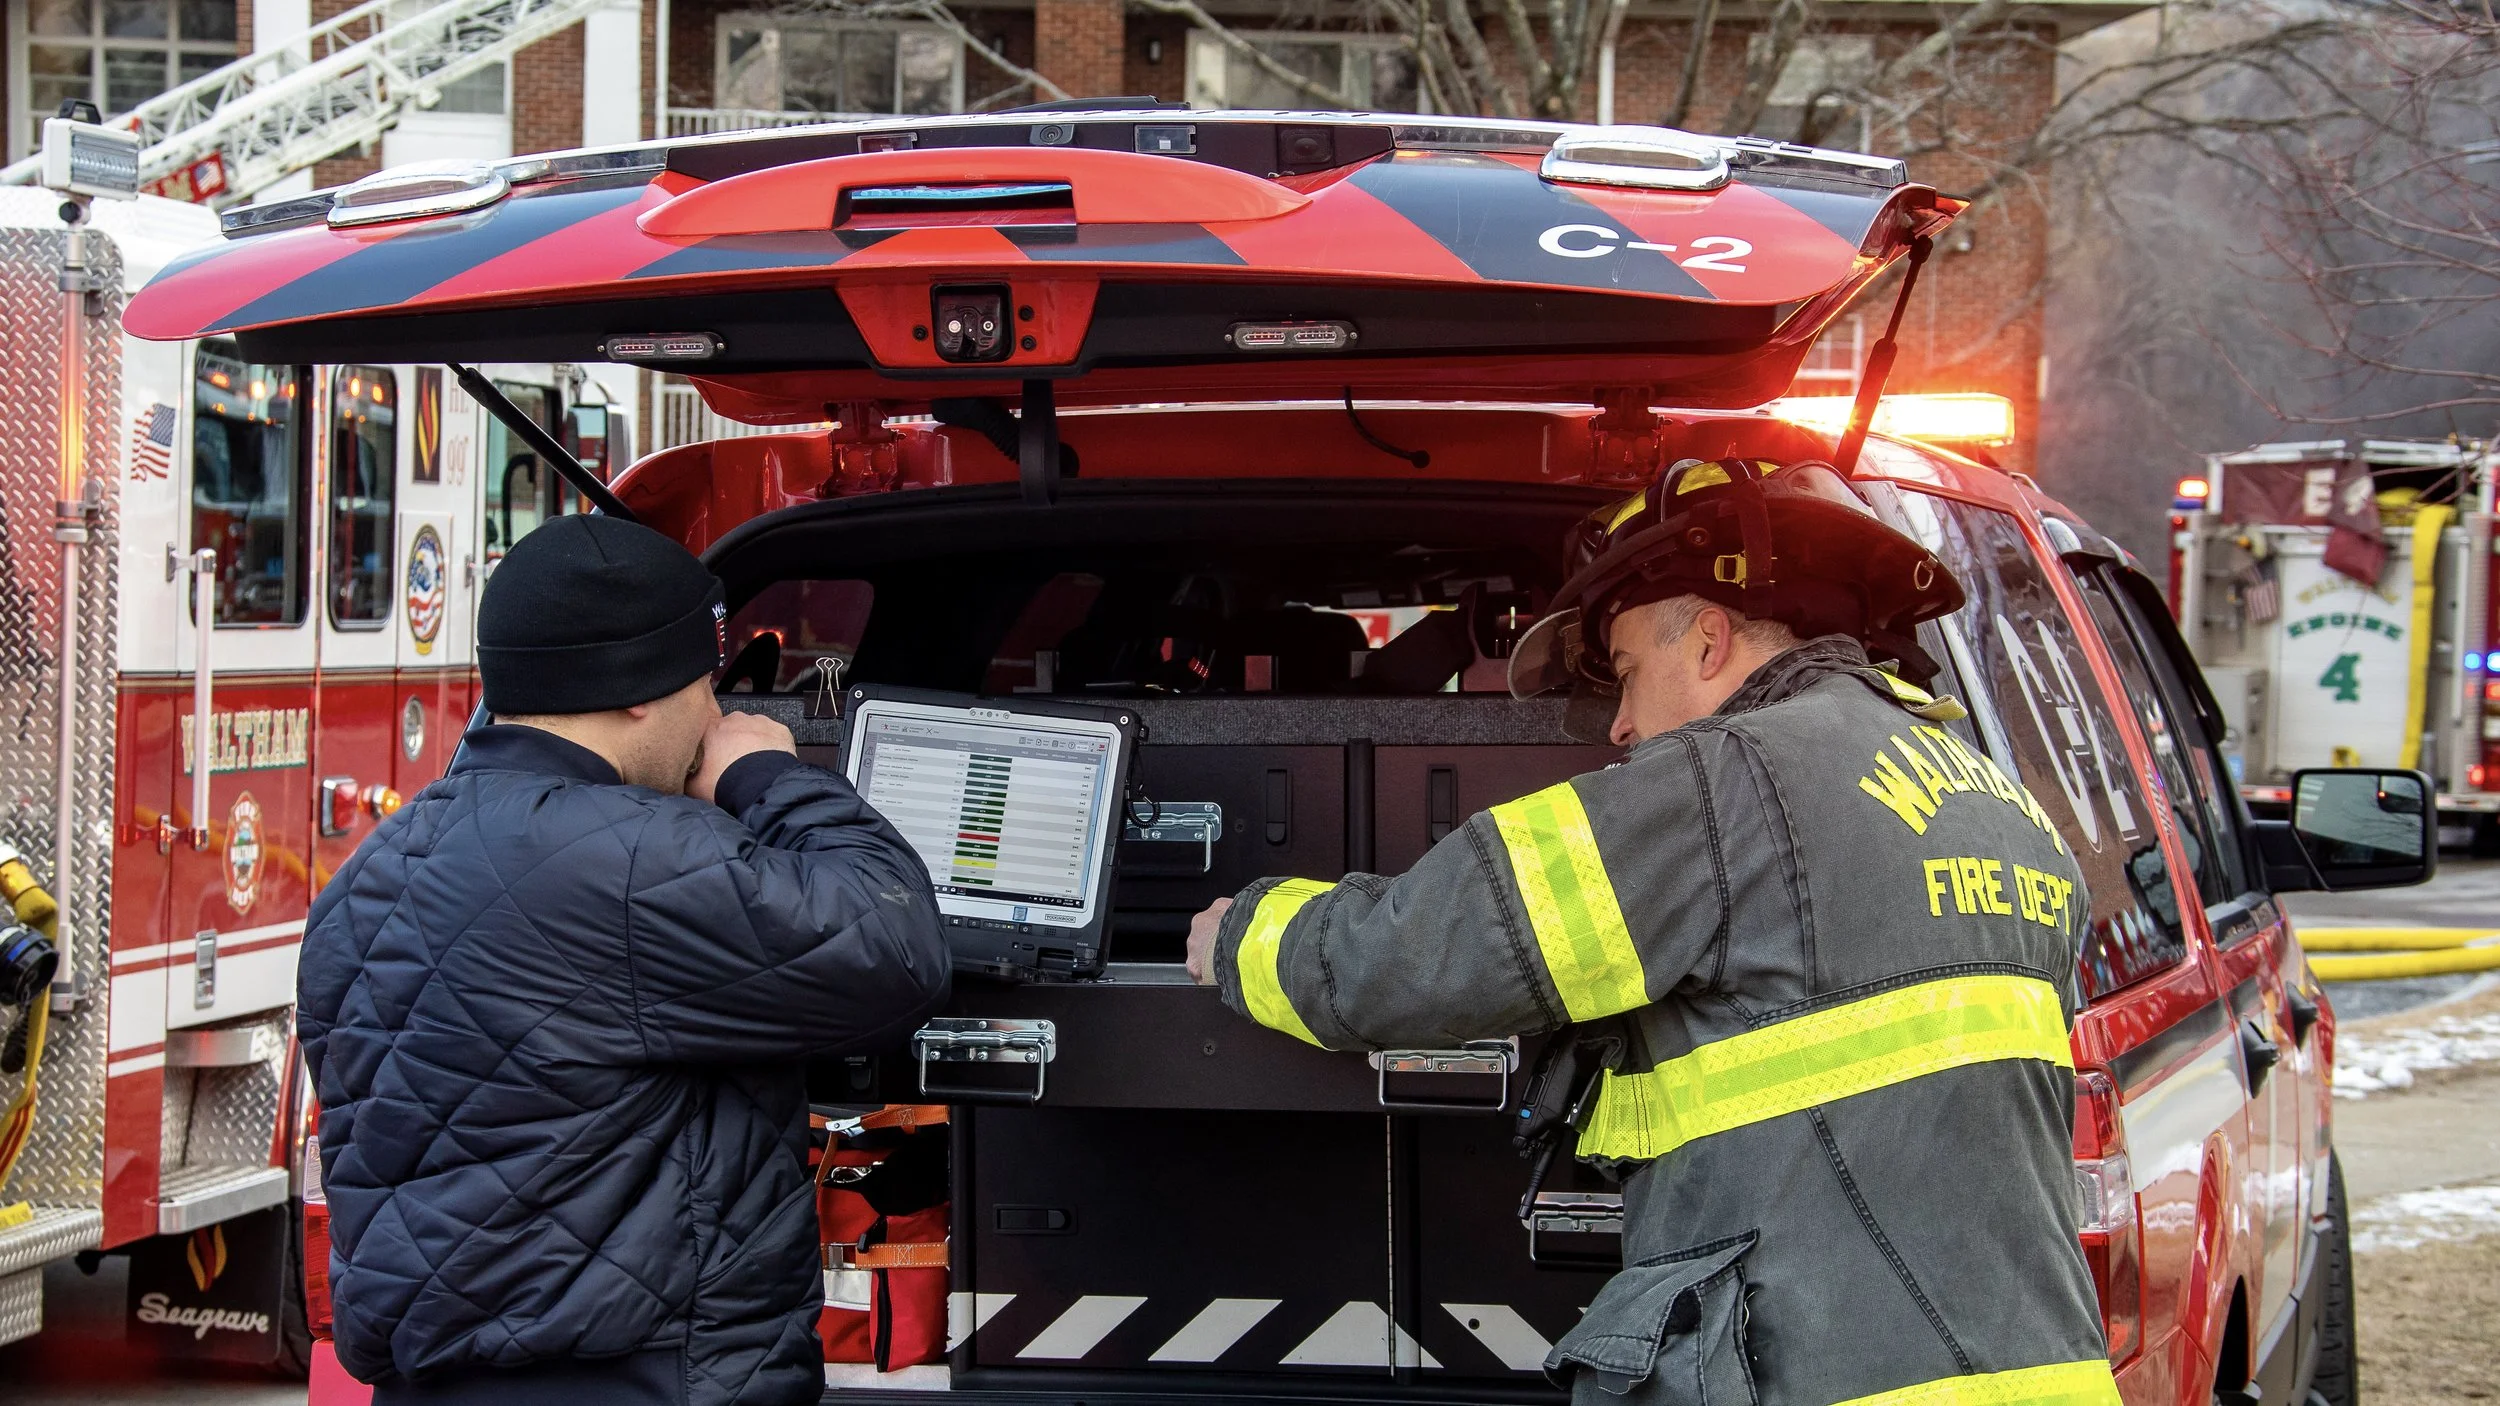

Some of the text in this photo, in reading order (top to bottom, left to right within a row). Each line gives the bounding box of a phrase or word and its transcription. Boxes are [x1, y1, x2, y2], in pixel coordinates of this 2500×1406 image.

[1538, 223, 1753, 274] C-2
[2287, 611, 2404, 641] ENGINE
[2318, 652, 2362, 703] 4
[1922, 856, 2073, 937] FIRE DEPT
[136, 1292, 269, 1340] Seagrave
